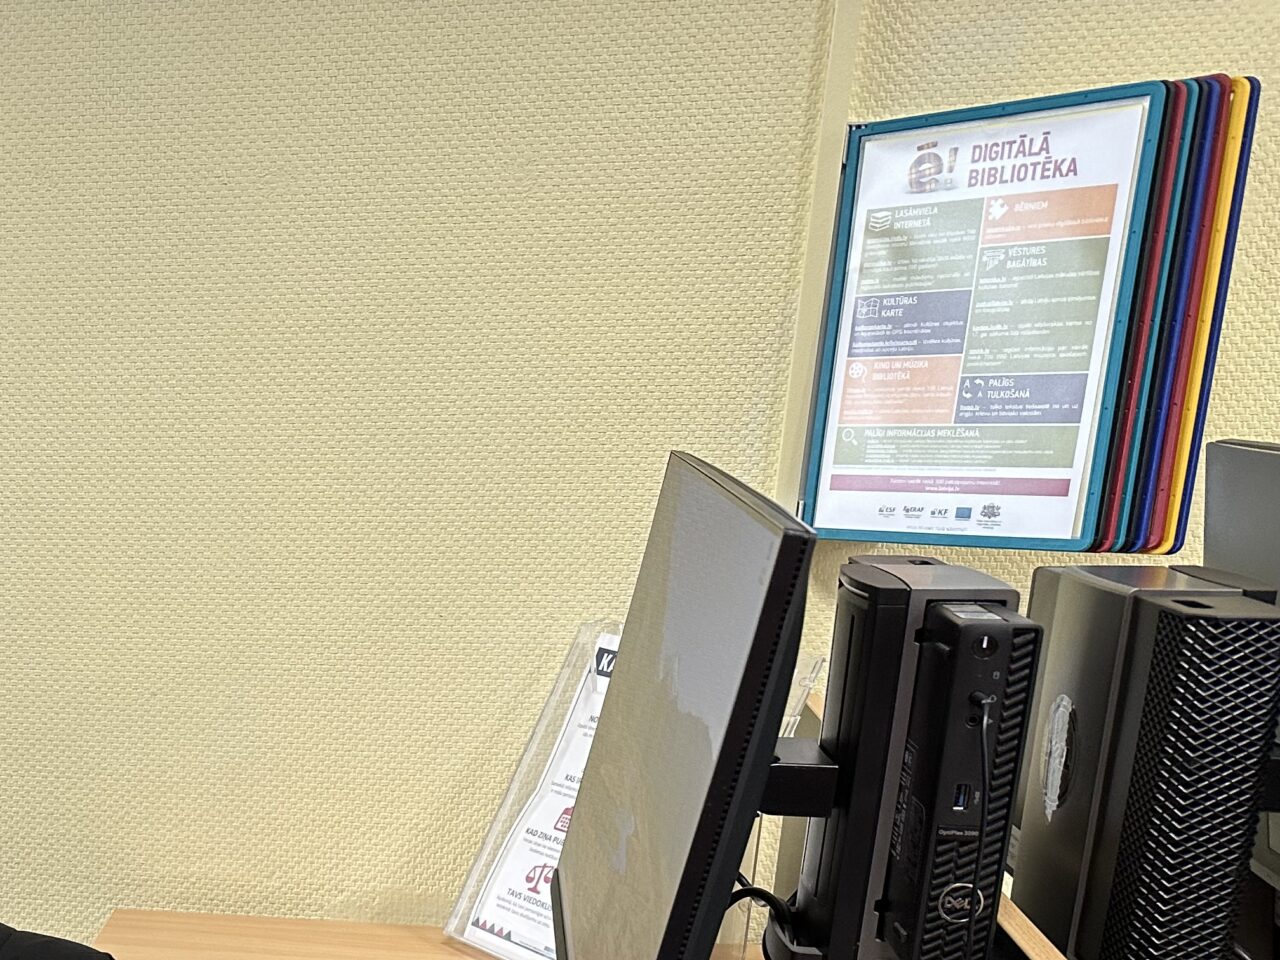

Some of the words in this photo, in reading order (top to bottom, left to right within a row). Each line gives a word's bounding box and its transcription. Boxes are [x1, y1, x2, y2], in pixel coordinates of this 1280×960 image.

[971, 131, 1051, 163] DIGITĀLĀ
[968, 156, 1078, 188] BIBLIOTĒKA
[895, 206, 938, 218] LASĀMVIELA
[893, 217, 931, 229] INTERNETĀ
[1008, 246, 1046, 257] VĒSTURES
[1006, 257, 1048, 269] BAGĀTĪBAS
[882, 296, 918, 306] KULTŪRAS
[881, 308, 904, 317] KARTE
[873, 361, 891, 369] KINO
[891, 361, 901, 369] UN
[872, 371, 911, 381] BIBLIOTĒKĀ
[988, 377, 1015, 387] PALĪGS
[987, 388, 1030, 399] TULKOŠANĀ
[886, 428, 935, 438] INFORMĀCIJAS
[936, 427, 980, 438] MEKLĒŠANĀ
[938, 508, 949, 516] KF
[525, 827, 539, 838] KAD
[507, 888, 522, 900] TAVS
[944, 896, 978, 909] DEL
